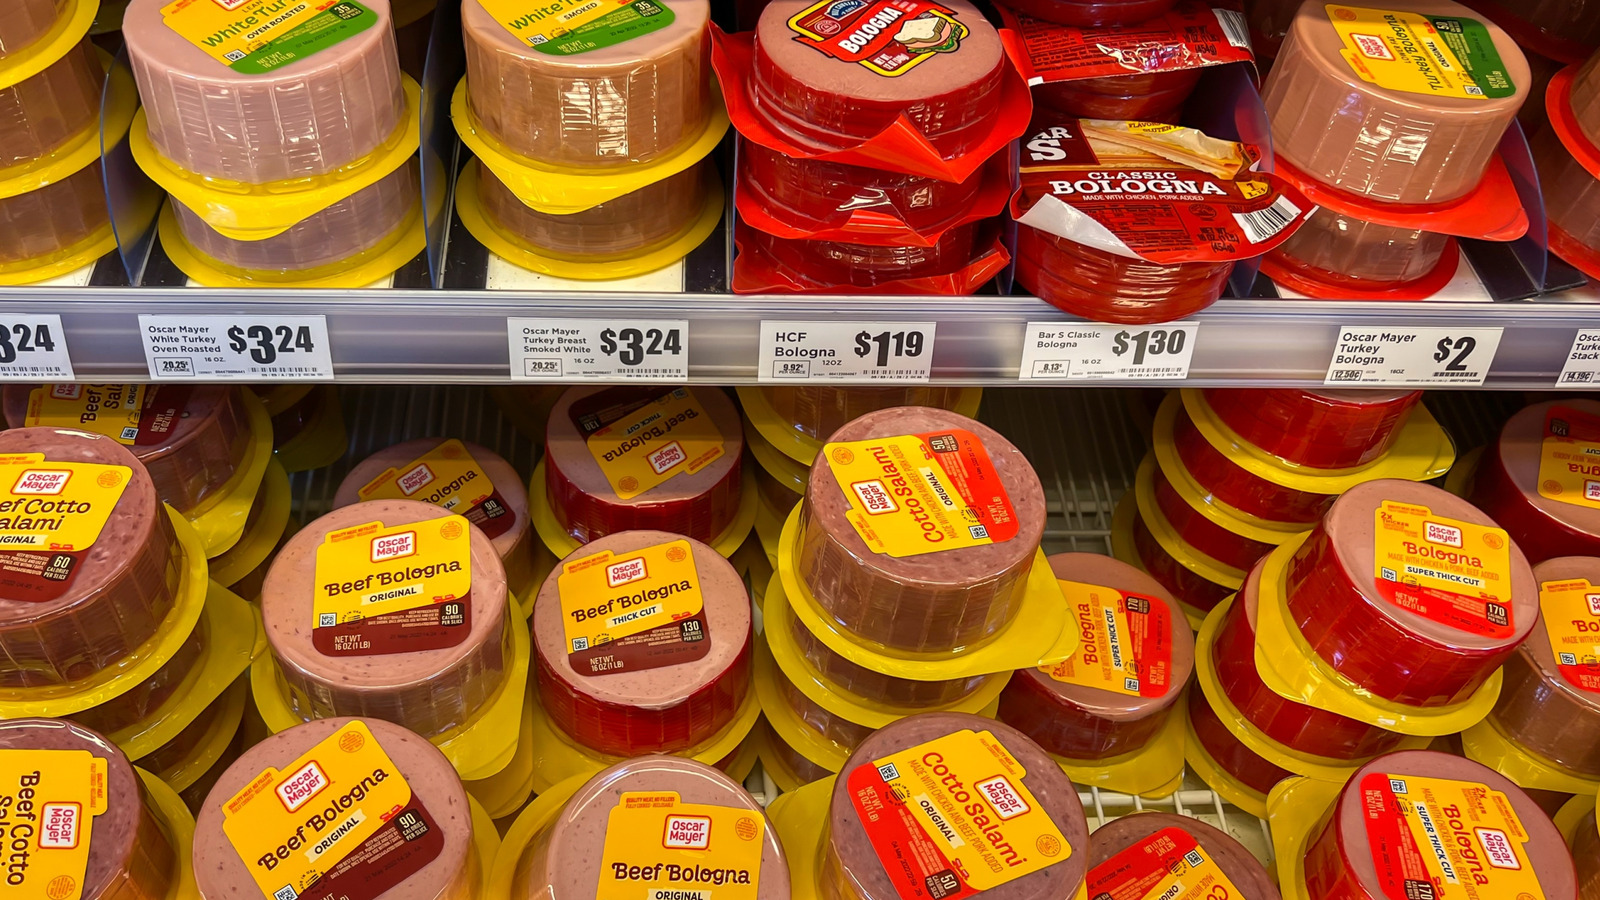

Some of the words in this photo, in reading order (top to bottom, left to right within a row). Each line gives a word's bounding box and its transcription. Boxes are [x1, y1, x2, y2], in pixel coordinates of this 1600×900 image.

[334, 4, 349, 14] 35
[564, 2, 597, 20] SMOKED
[636, 1, 650, 11] 35
[247, 25, 270, 39] OVEN
[270, 4, 306, 26] ROASTED
[508, 1, 564, 30] White
[201, 16, 259, 47] White
[838, 7, 902, 54] BOLOGNA
[1384, 14, 1418, 54] Bologna
[1426, 41, 1450, 68] ORIGINAL
[1412, 55, 1444, 90] Turkey
[1031, 127, 1072, 140] AR
[1027, 139, 1067, 161] S
[1088, 172, 1177, 180] CLASSIC
[1049, 179, 1227, 196] BOLOGNA
[148, 325, 176, 333] Oscar
[180, 326, 209, 335] Mayer
[552, 328, 580, 336] Mayer
[775, 332, 807, 342] HCF
[1068, 331, 1100, 339] Classic
[1342, 332, 1377, 343] Oscar
[1380, 333, 1416, 344] Mayer
[151, 335, 180, 343] White
[182, 336, 216, 345] Turkey
[523, 337, 555, 345] Turkey
[1037, 341, 1078, 349] Bologna
[152, 345, 178, 353] Oven
[181, 345, 221, 353] Roasted
[775, 347, 836, 358] Bologna
[1340, 344, 1380, 354] Turkey
[1433, 336, 1477, 371] $2
[1335, 355, 1385, 365] Bologna
[80, 389, 102, 424] Beef
[664, 408, 700, 432] Beef
[602, 427, 665, 462] Bologna
[932, 439, 945, 450] 50
[653, 446, 678, 464] Mayer
[658, 453, 681, 470] Oscar
[27, 473, 64, 481] Oscar
[402, 468, 424, 484] Oscar
[865, 446, 913, 497] Salami
[20, 481, 60, 491] Mayer
[405, 472, 430, 491] Mayer
[926, 472, 952, 506] ORIGINAL
[485, 500, 497, 510] 90
[859, 487, 880, 510] Oscar
[867, 484, 891, 510] Mayer
[25, 499, 91, 514] Cotto
[905, 497, 945, 543] Cotto
[1429, 525, 1456, 536] Oscar
[1429, 532, 1458, 543] Mayer
[376, 543, 411, 556] Mayer
[377, 535, 410, 548] Oscar
[54, 556, 70, 568] 60
[1388, 552, 1404, 561] MADE
[1405, 555, 1420, 565] WITH
[1403, 541, 1483, 568] Bologna
[612, 561, 640, 574] Oscar
[612, 568, 642, 582] Mayer
[1407, 566, 1435, 577] SUPER
[1437, 572, 1462, 583] THICK
[1463, 577, 1480, 586] CUT
[324, 575, 374, 597] Beef
[376, 560, 462, 586] Bologna
[369, 587, 417, 603] ORIGINAL
[571, 599, 615, 623] Beef
[617, 580, 692, 609] Bologna
[445, 604, 458, 615] 90
[1128, 598, 1138, 610] 170
[1488, 603, 1506, 617] 170
[612, 612, 639, 625] THICK
[640, 606, 657, 617] CUT
[1105, 610, 1113, 623] CUT
[683, 620, 699, 632] 130
[1078, 604, 1098, 665] Bologna
[1108, 624, 1118, 643] THICK
[334, 635, 349, 644] NET
[350, 634, 361, 643] WT
[342, 642, 352, 650] OZ
[590, 656, 603, 665] NET
[603, 655, 614, 663] WT
[1112, 645, 1121, 667] SUPER
[591, 664, 598, 672] 16
[598, 663, 607, 671] OZ
[284, 767, 314, 795] Oscar
[288, 774, 321, 804] Mayer
[16, 770, 41, 822] Beef
[857, 789, 867, 797] 16
[861, 796, 871, 806] OZ
[865, 786, 878, 798] NET
[872, 798, 884, 810] WT
[983, 783, 1014, 814] Mayer
[994, 782, 1022, 810] Oscar
[908, 759, 927, 776] MADE
[920, 774, 937, 790] WITH
[931, 788, 956, 813] CHICKEN
[949, 809, 965, 825] AND
[971, 837, 989, 855] PORK
[983, 853, 1003, 873] ADDED
[922, 752, 971, 804] Cotto
[964, 802, 1028, 868] Salami
[46, 808, 63, 843] Mayer
[60, 809, 74, 842] Oscar
[257, 825, 308, 872] Beef
[306, 768, 389, 832] Bologna
[399, 813, 416, 828] 90
[672, 820, 705, 832] Oscar
[920, 800, 955, 842] ORIGINAL
[314, 818, 359, 855] ORIGINAL
[670, 830, 705, 844] Mayer
[1417, 806, 1434, 833] SUPER
[1429, 835, 1446, 859] THICK
[1441, 861, 1456, 880] CUT
[1442, 804, 1489, 886] Bologna
[7, 824, 34, 886] Cotto
[1482, 832, 1504, 864] Mayer
[1493, 835, 1513, 864] Oscar
[612, 862, 664, 880] Beef
[666, 864, 751, 885] Bologna
[940, 874, 957, 890] 50
[655, 891, 704, 900] ORIGINAL
[1418, 883, 1433, 900] 170
